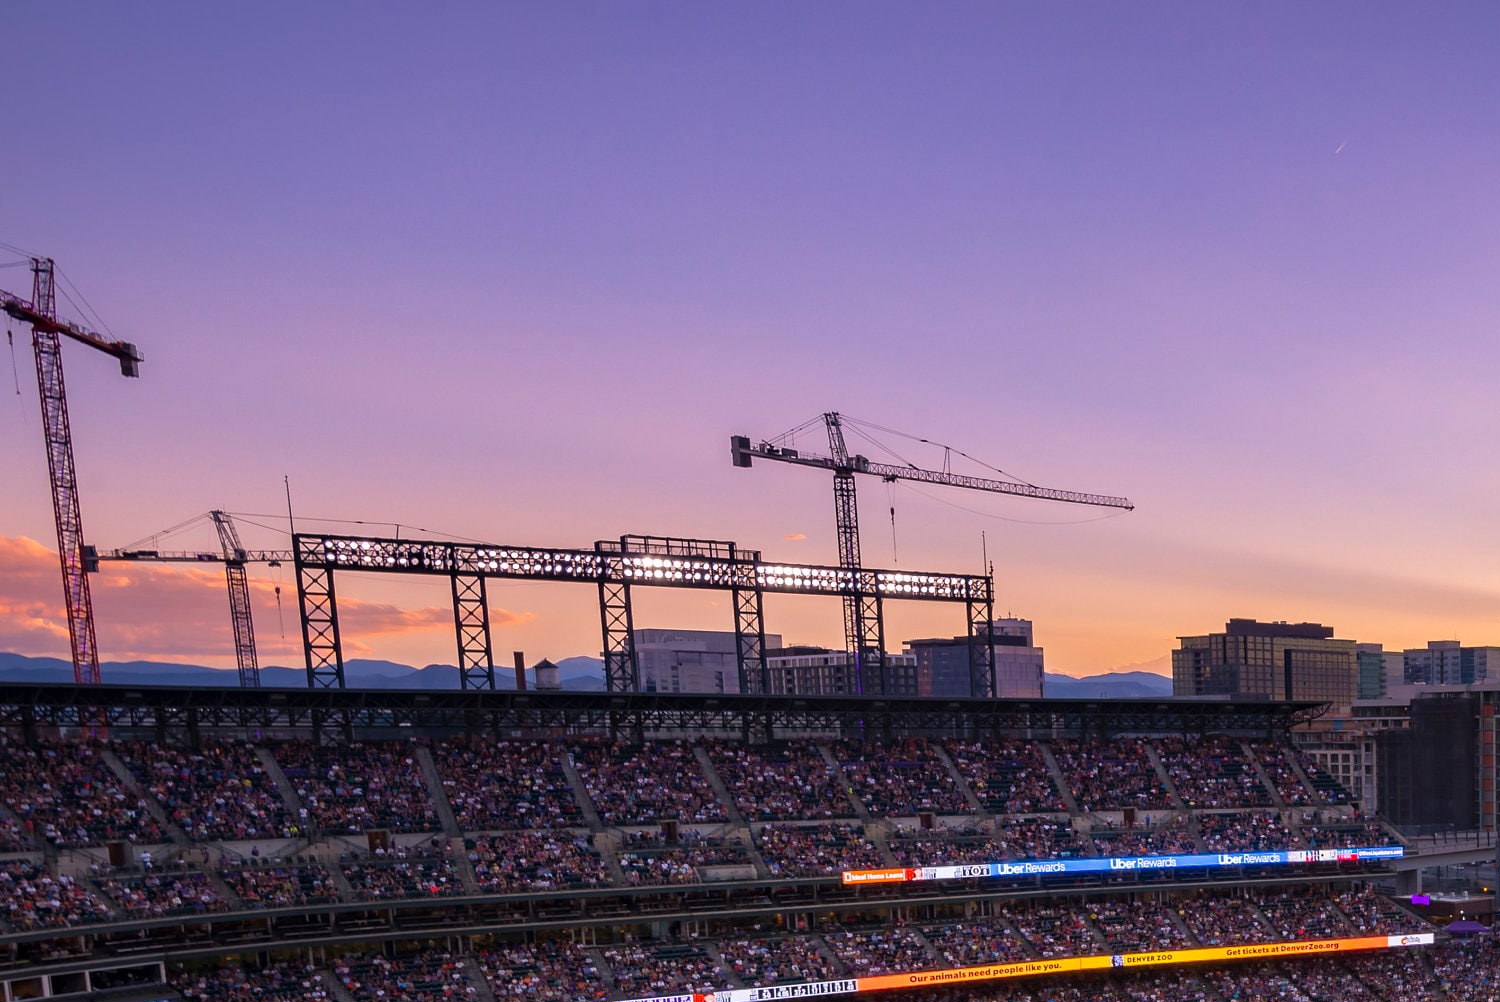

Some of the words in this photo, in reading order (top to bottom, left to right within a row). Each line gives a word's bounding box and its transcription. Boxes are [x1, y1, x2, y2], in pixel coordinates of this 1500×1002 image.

[1110, 858, 1136, 870] Uber
[1137, 857, 1177, 868] Rewards
[1218, 854, 1243, 865] Uber
[1244, 852, 1280, 863] Rewards
[998, 864, 1024, 874] Uber
[1026, 862, 1066, 872] Rewards
[867, 872, 885, 880] Home
[886, 872, 904, 880] Loans
[1242, 946, 1270, 956] tickets
[1270, 946, 1280, 954] at
[1280, 942, 1340, 952] DenverZoo.org
[1127, 955, 1155, 964] DENVER
[1156, 954, 1173, 962] ZOO
[909, 974, 928, 984] Our
[929, 971, 967, 982] animals
[968, 967, 992, 978] need
[992, 965, 1024, 977] people
[1025, 962, 1042, 972] like
[1043, 962, 1062, 972] you.
